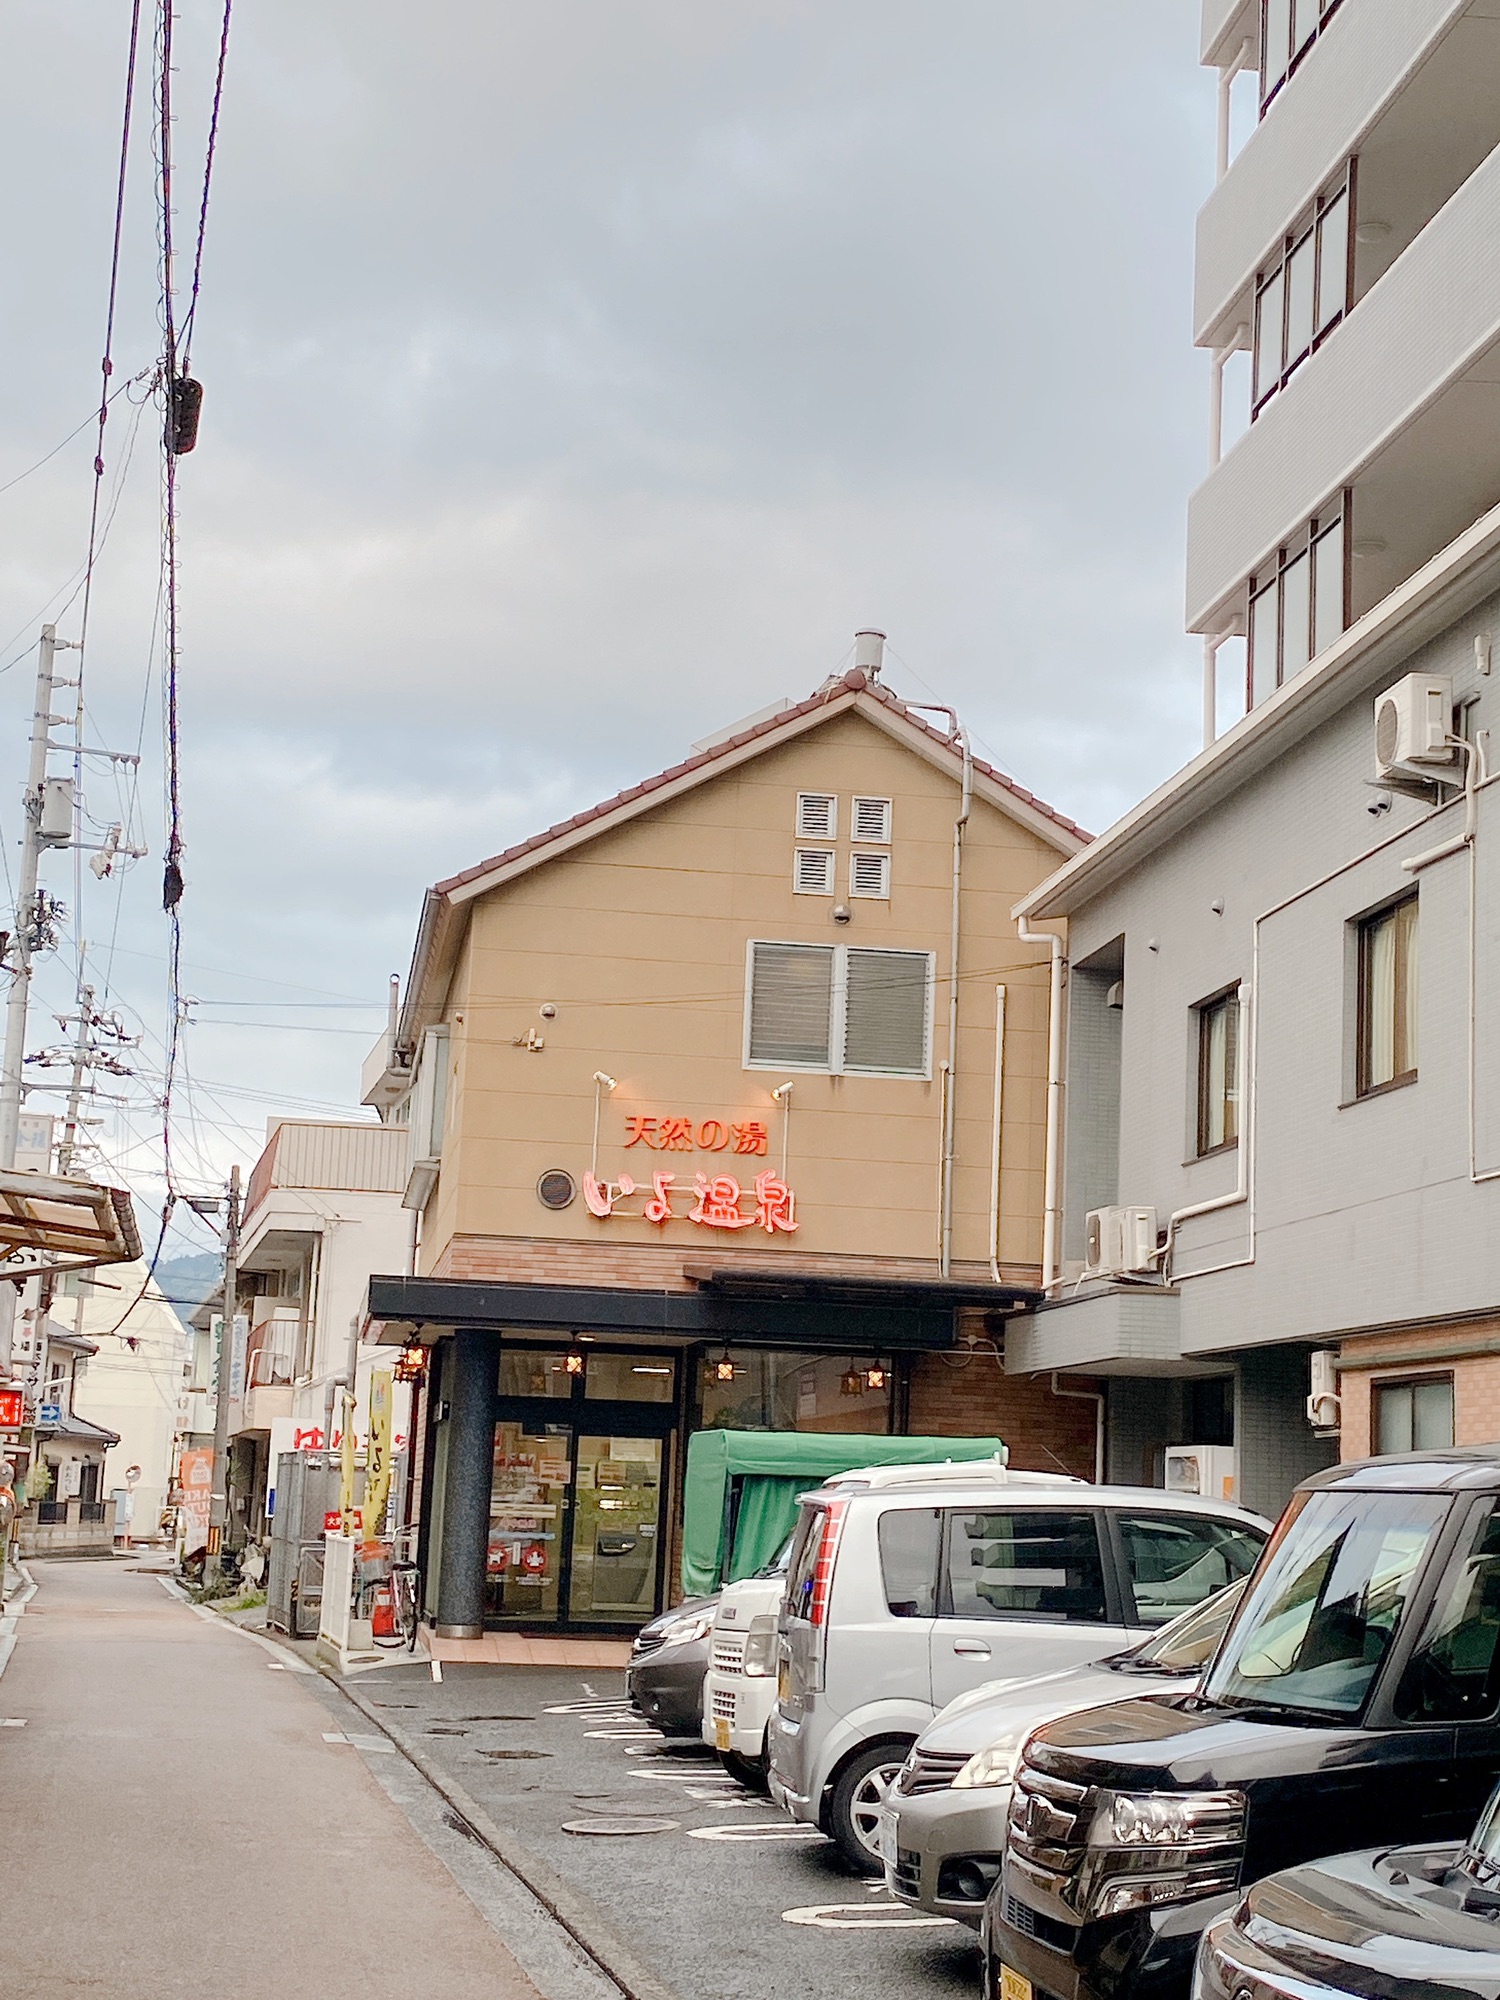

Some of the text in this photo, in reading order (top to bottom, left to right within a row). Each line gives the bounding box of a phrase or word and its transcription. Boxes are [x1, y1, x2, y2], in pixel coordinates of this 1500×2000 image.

[624, 1115, 768, 1156] 天然の湯
[582, 1168, 799, 1234] いよ温泉
